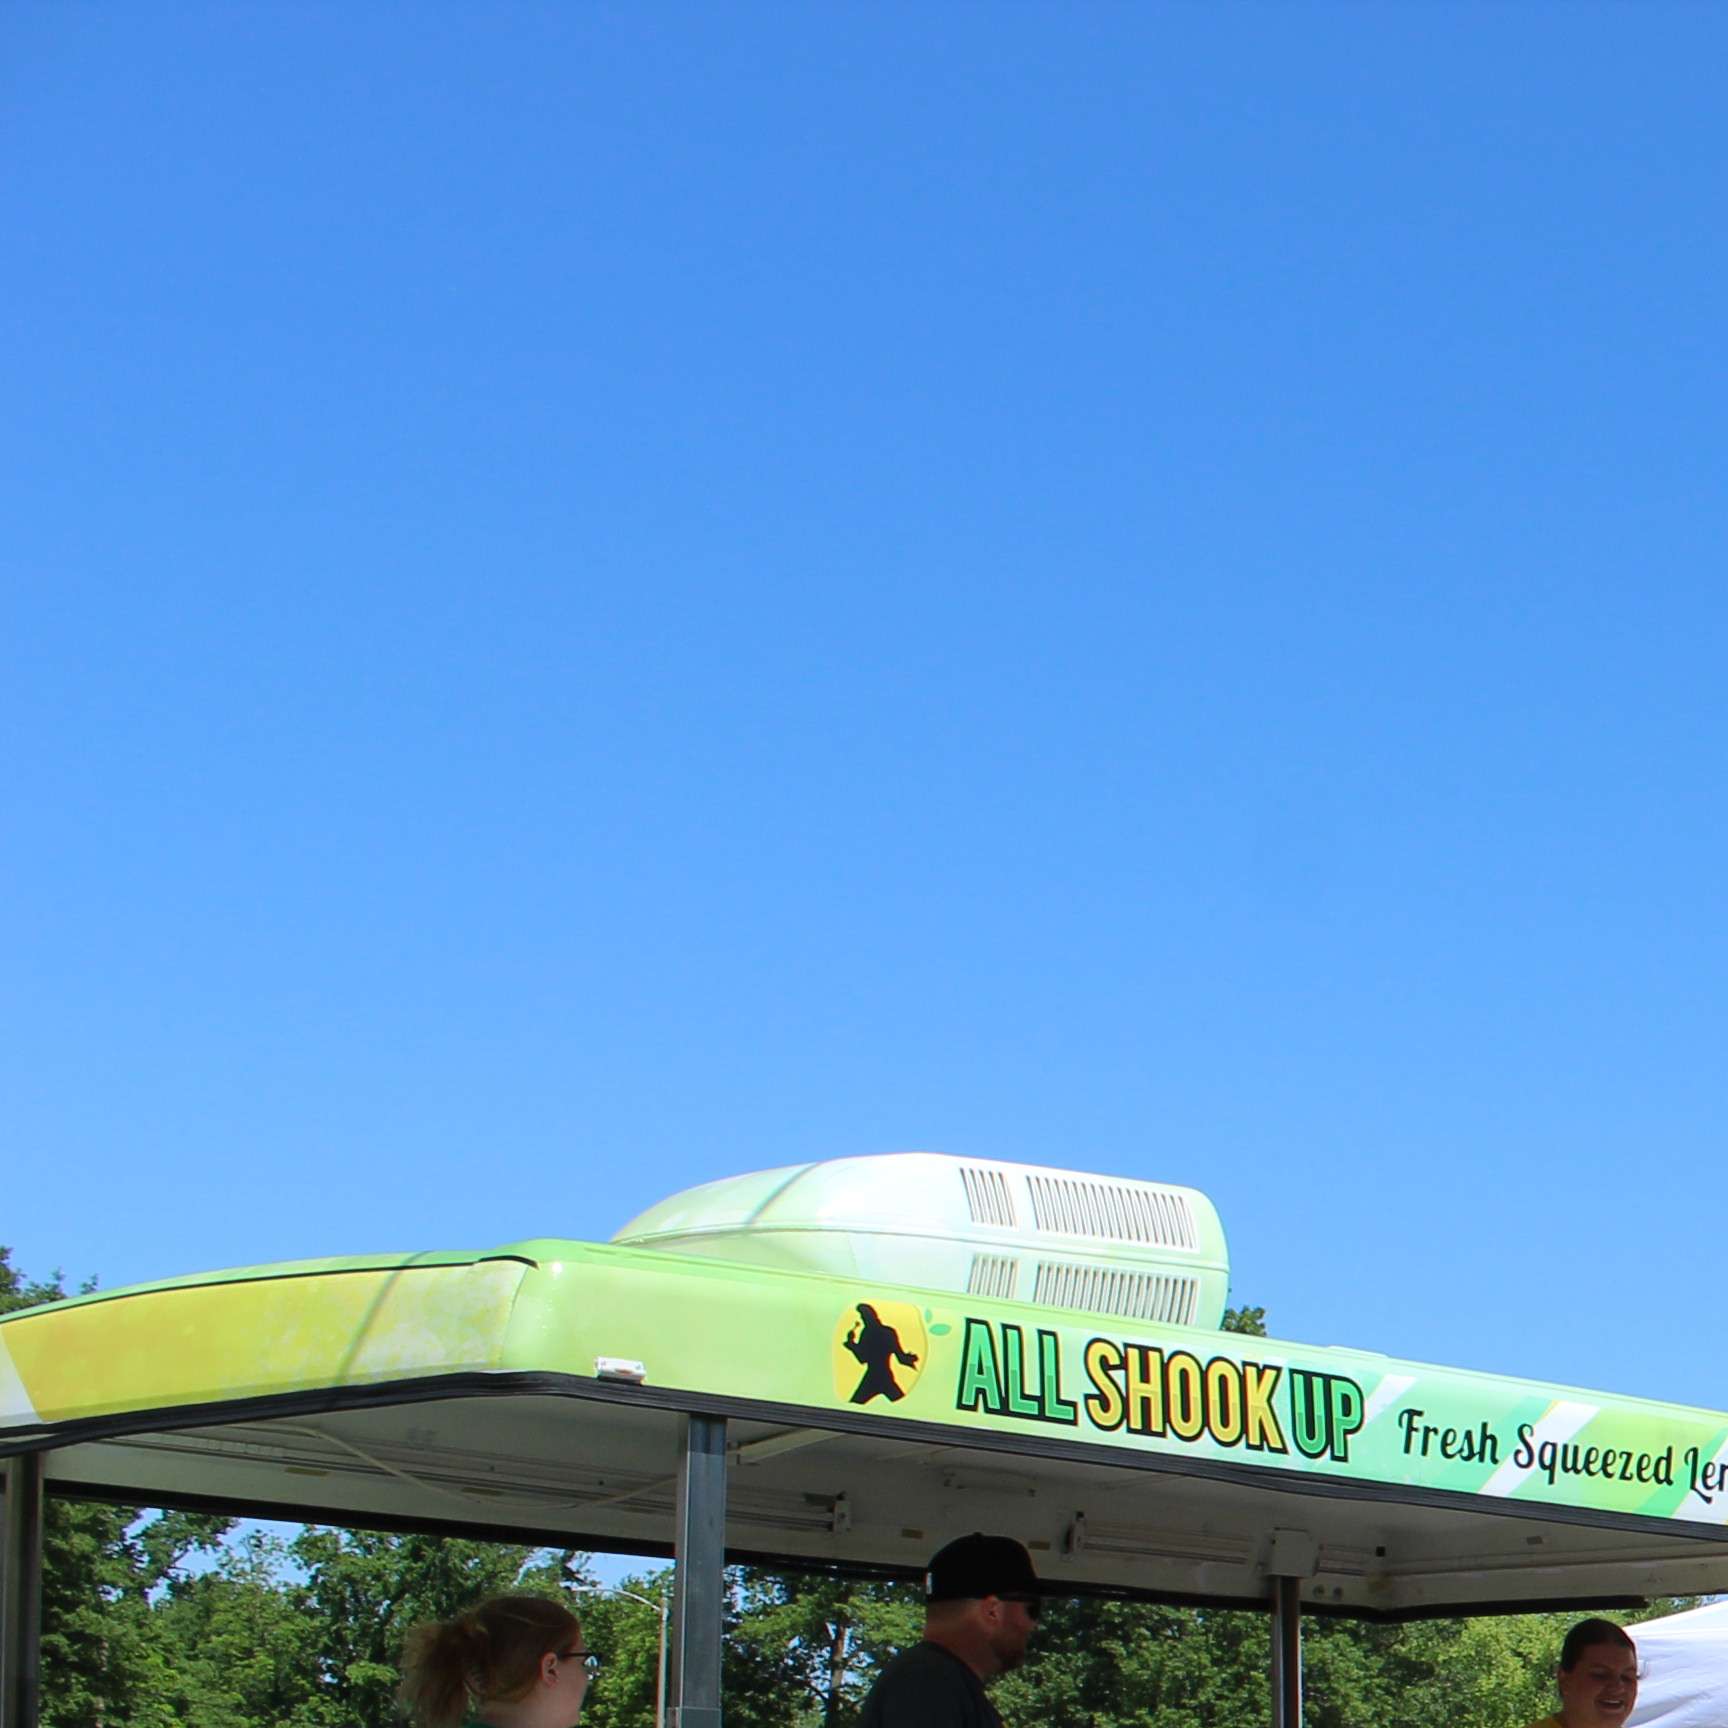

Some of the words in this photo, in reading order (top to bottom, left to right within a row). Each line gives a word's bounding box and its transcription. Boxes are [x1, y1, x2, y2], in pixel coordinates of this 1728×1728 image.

[956, 1317, 1078, 1426] ALL
[1084, 1337, 1289, 1455] SHOOK
[1290, 1369, 1365, 1462] UP
[1398, 1408, 1500, 1465] Fresh
[1513, 1423, 1674, 1485] Squeezed
